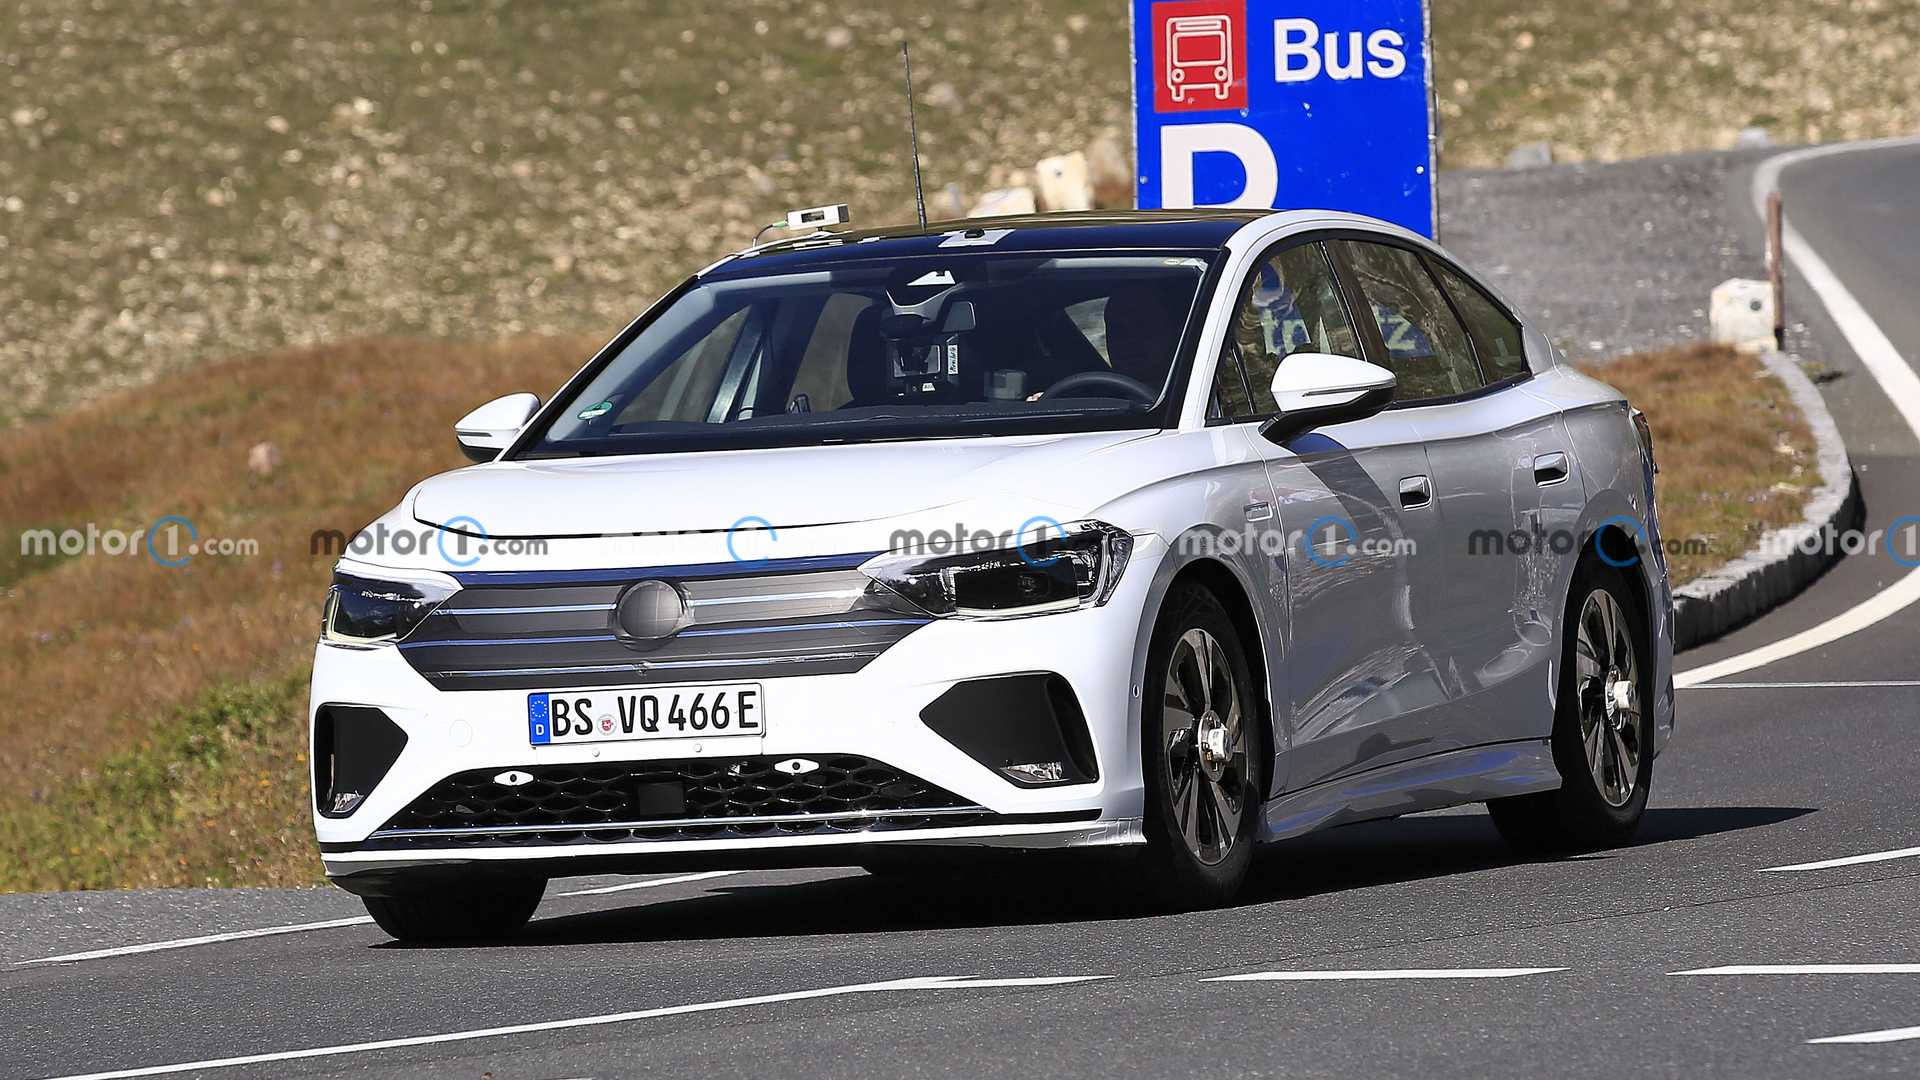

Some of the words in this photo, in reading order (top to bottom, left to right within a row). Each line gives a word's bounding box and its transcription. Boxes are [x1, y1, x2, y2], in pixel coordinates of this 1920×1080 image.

[1274, 17, 1407, 82] Bus
[535, 723, 545, 736] D
[551, 698, 594, 737] BS
[618, 695, 660, 734] VQ
